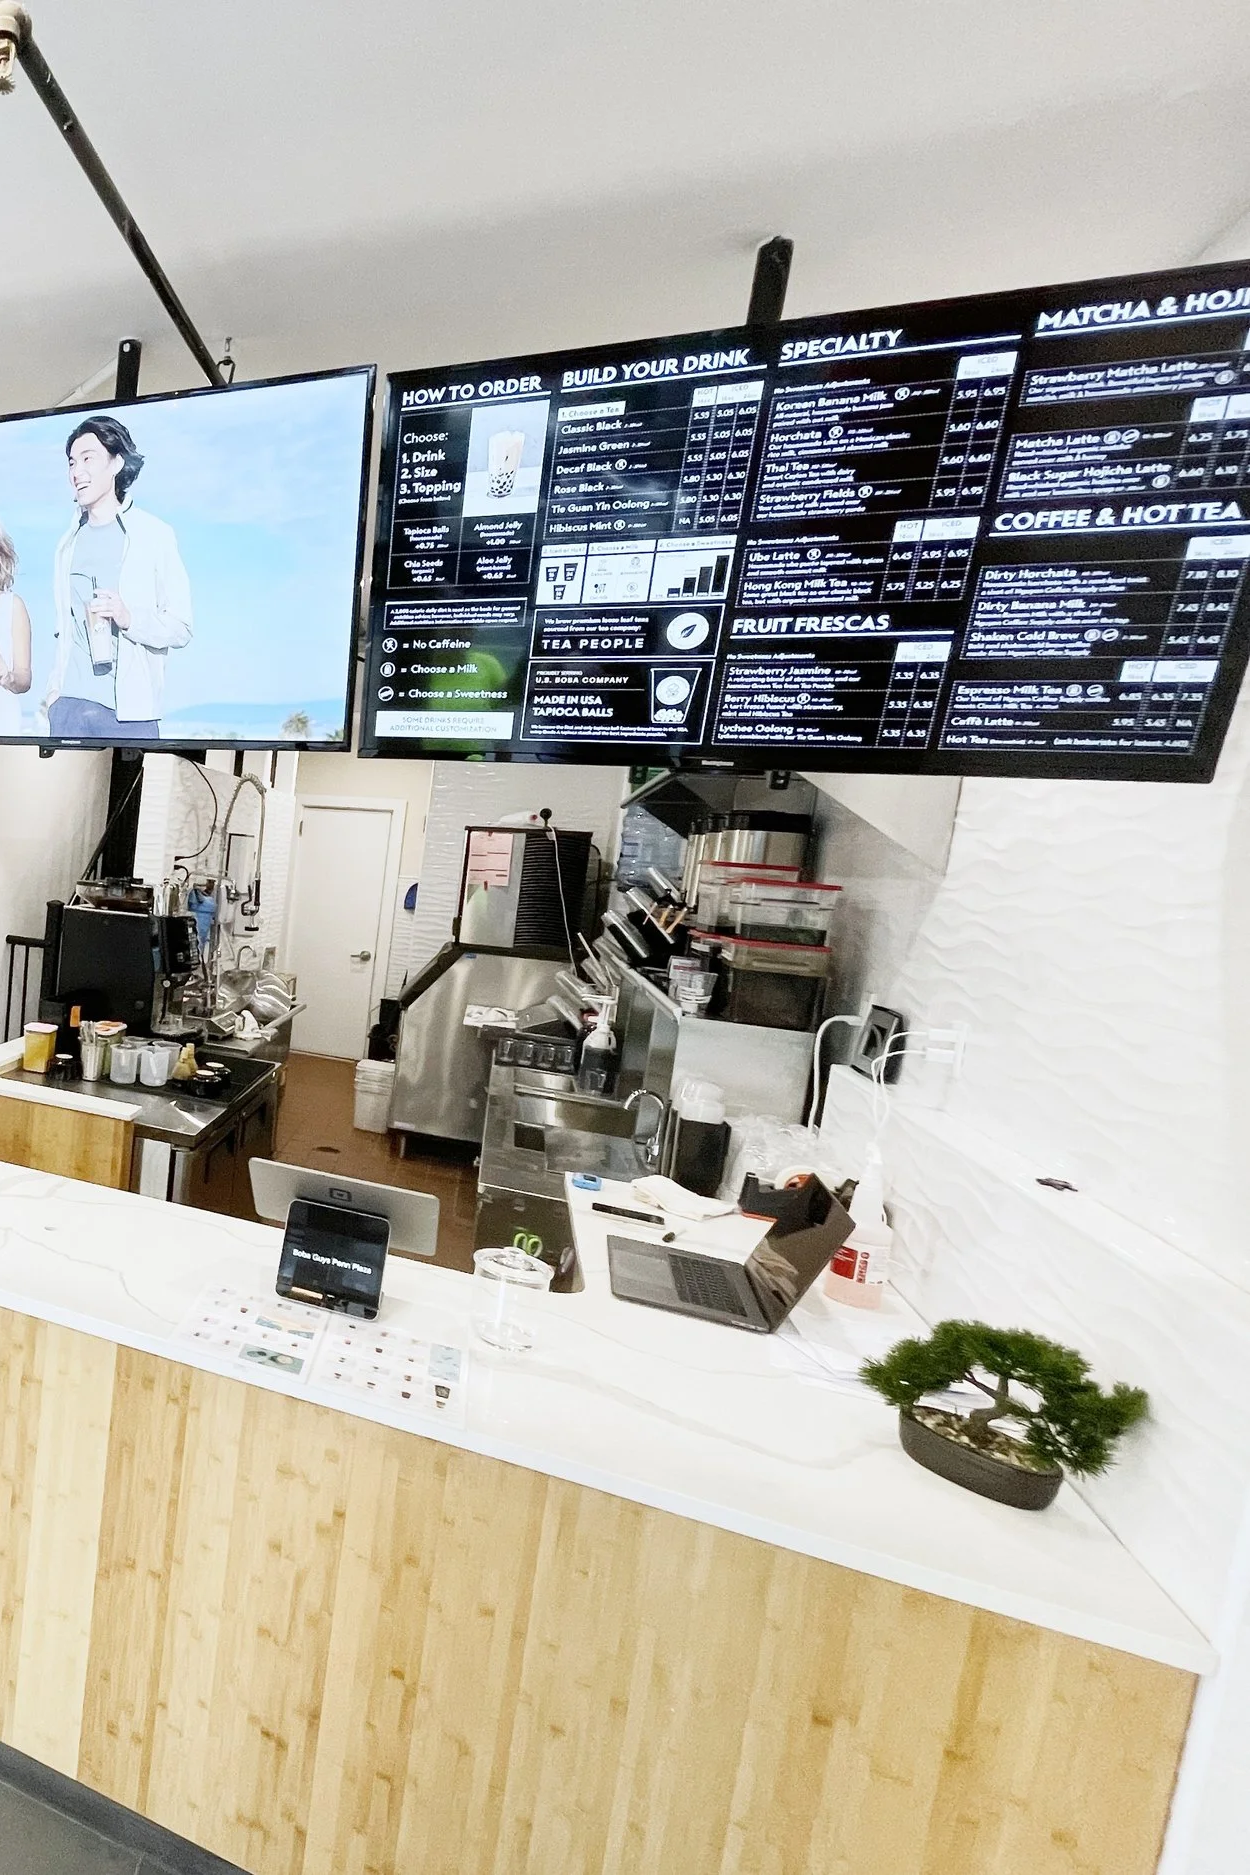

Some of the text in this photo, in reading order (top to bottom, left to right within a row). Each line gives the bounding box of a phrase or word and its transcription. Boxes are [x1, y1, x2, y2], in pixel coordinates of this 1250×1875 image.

[1037, 299, 1151, 330] MATCHA
[1156, 296, 1179, 317] &
[780, 328, 903, 361] SPECIALTY
[562, 348, 750, 387] BUILD YOUR DRINK
[1030, 361, 1198, 386] Strawberry Matcha Latte
[402, 375, 542, 406] HOW TO ORDER
[956, 386, 1006, 399] 5.95 6.95
[775, 390, 888, 411] Korean Banana Milk
[568, 409, 598, 418] Choose
[606, 406, 620, 414] Tea
[561, 420, 622, 434] Classic Black
[975, 420, 999, 431] 6.60
[403, 432, 449, 444] Choose:
[770, 430, 822, 442] Horchata
[1015, 433, 1100, 449] Matcha Latte
[558, 440, 630, 454] Jasmine Green
[401, 449, 445, 464] 1. Drink
[941, 453, 991, 465] 5.60 6.60
[400, 466, 438, 479] 2. Size
[556, 460, 612, 474] Decaf Black
[765, 460, 810, 474] Thai Tea
[1008, 462, 1172, 482] Black Sugar Hojicha Latte
[727, 470, 745, 480] 6.30
[399, 480, 461, 496] 3. Topping
[553, 481, 604, 494] Rose Black
[935, 485, 985, 497] 5.95 6.95
[759, 487, 855, 504] Strawberry Fields
[551, 499, 650, 514] Tie Guan Yin Oolong
[994, 500, 1242, 531] COFFEE & HOT TEA
[403, 525, 450, 538] Tapioca Balls
[473, 520, 523, 531] Almond Jelly
[549, 519, 612, 533] Hibiscus Mint
[476, 556, 512, 566] Aloe Jelly
[749, 551, 801, 562] Ube Latte
[403, 559, 443, 569] Chia Seeds
[984, 568, 1077, 581] Dirty Horchata
[743, 577, 848, 593] Hong Kong Milk Tea
[977, 598, 1086, 612] Dirty Banana Milk
[555, 617, 572, 625] brew
[572, 617, 601, 626] premium
[620, 616, 634, 624] leaf
[732, 614, 890, 633] FRUIT FRESCAS
[970, 630, 1080, 642] Shaken Cold Brew
[412, 639, 471, 649] No Caffeine
[541, 637, 645, 650] TEA PEOPLE
[410, 664, 447, 674] Choose
[456, 664, 478, 674] Milk
[728, 665, 832, 677] Strawberry Jasmine
[554, 676, 579, 684] BOBA
[581, 676, 629, 684] COMPANY
[894, 671, 940, 680] 5.35 6.35
[408, 688, 507, 700] Choose a Sweetness
[957, 685, 1063, 697] Espresso Milk Tea
[533, 695, 602, 705] MADE IN USA
[724, 693, 796, 706] Berry Hibiscus
[887, 700, 933, 709] 5.35 6.35
[532, 707, 613, 718] TAPIOCA BALLS
[402, 716, 485, 725] SOME DRINKS REQUIRE
[983, 716, 1014, 726] Latte
[390, 724, 497, 733] ADDITIONAL CUSTOMIZATION
[719, 723, 794, 735] Lychee Oolong
[881, 729, 927, 738] 5.35 6.35
[946, 735, 989, 746] Hot Tea
[292, 1248, 372, 1275] Boba Guys Penn Plaza
